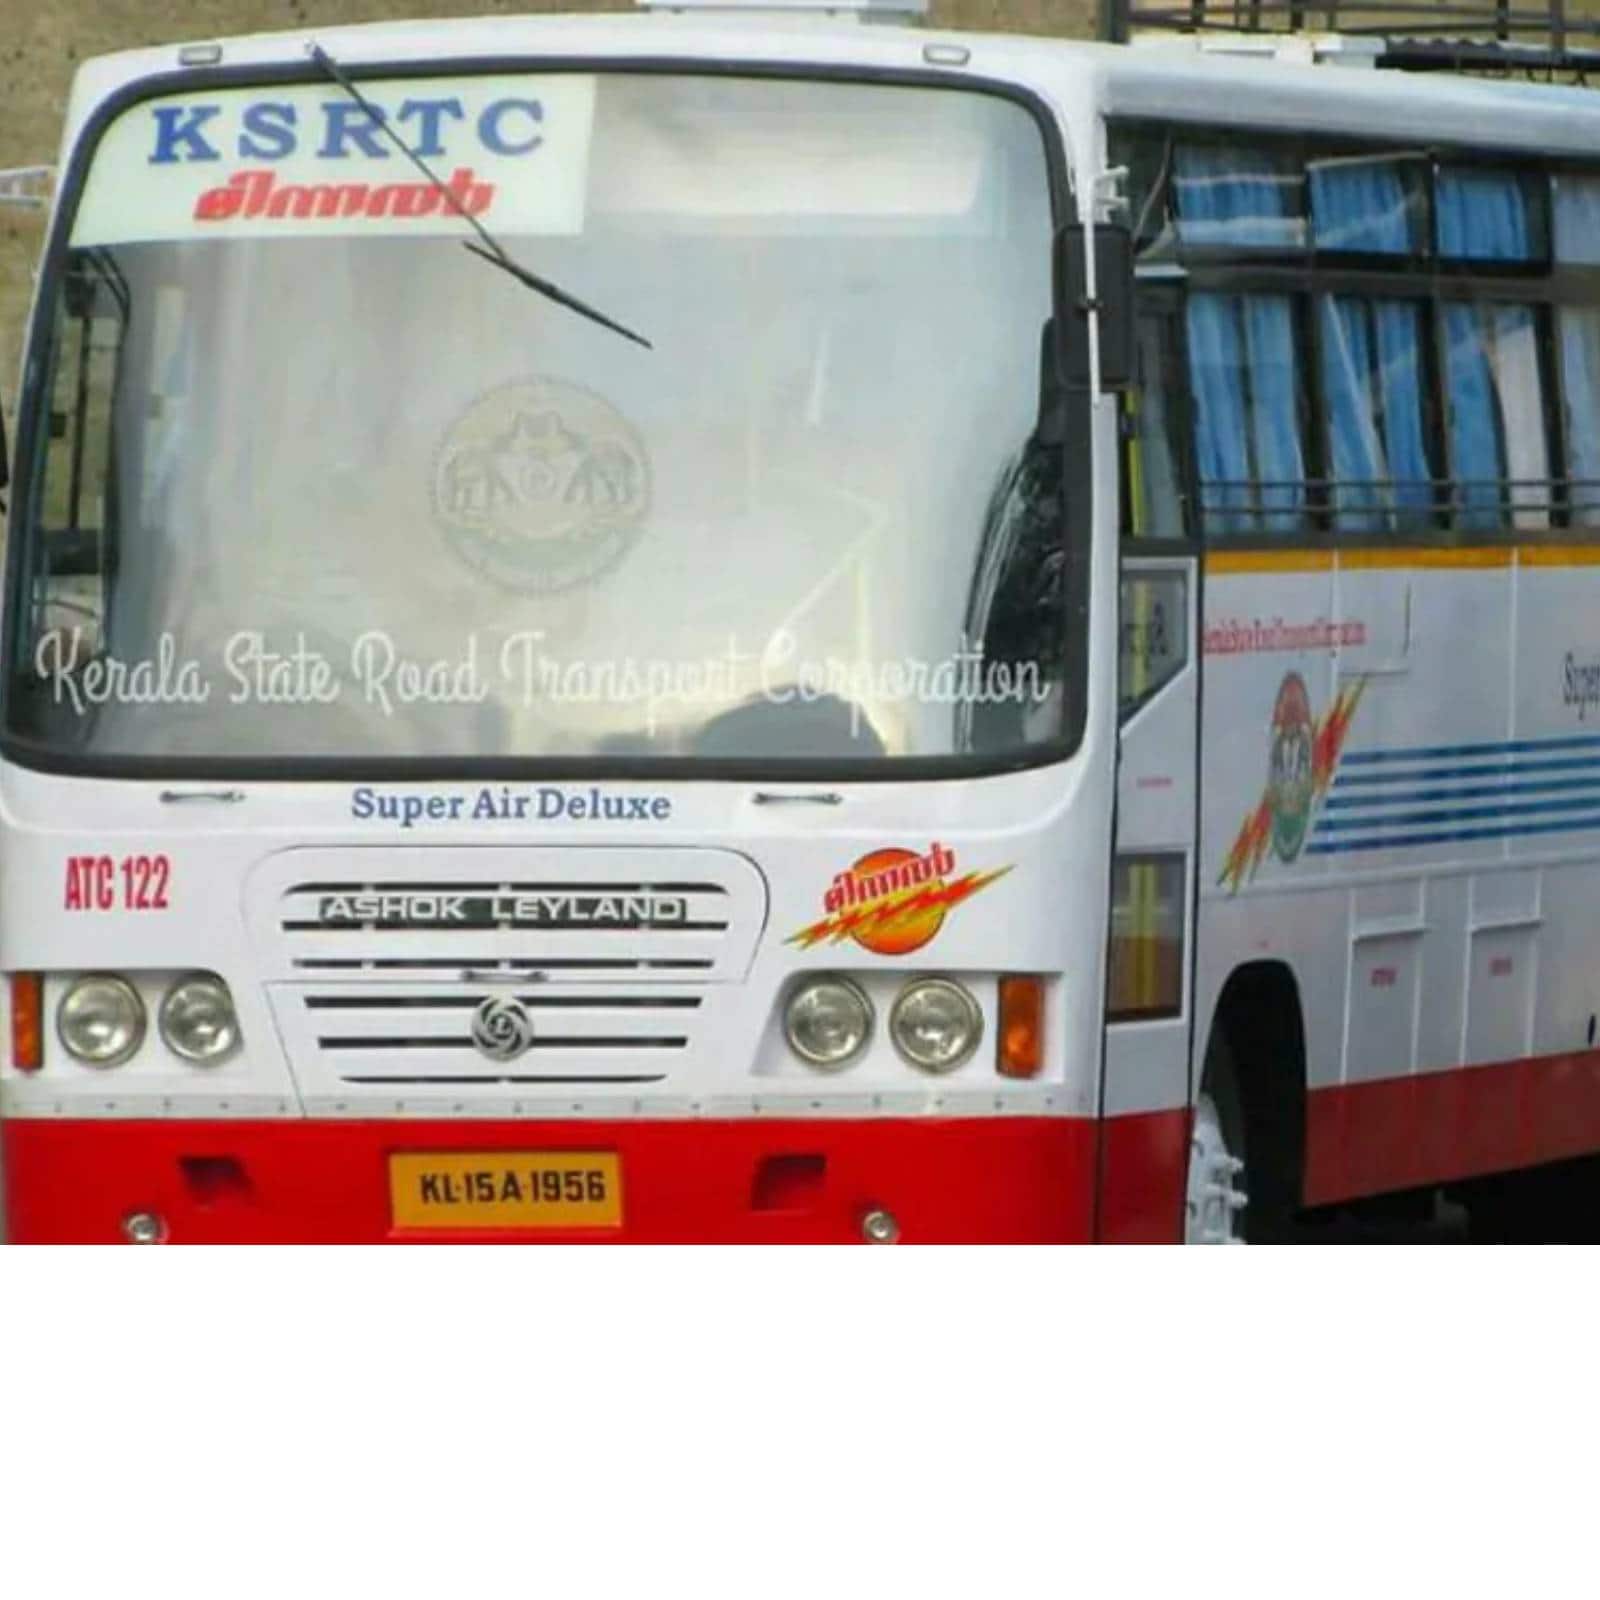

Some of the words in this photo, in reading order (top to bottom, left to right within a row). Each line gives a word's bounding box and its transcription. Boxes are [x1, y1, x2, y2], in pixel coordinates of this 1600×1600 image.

[147, 99, 544, 163] KSRTC
[35, 625, 209, 717] Kerala
[223, 630, 340, 704] State
[351, 631, 490, 718] Road
[501, 630, 758, 738] Transport
[760, 627, 1050, 739] Corporation
[351, 788, 464, 827] Super
[472, 788, 530, 819] Air
[537, 788, 672, 819] Deluxe
[64, 855, 113, 910] ATC
[121, 855, 169, 910] 122
[324, 897, 466, 920] ASHOK
[491, 897, 684, 920] LEYLAND
